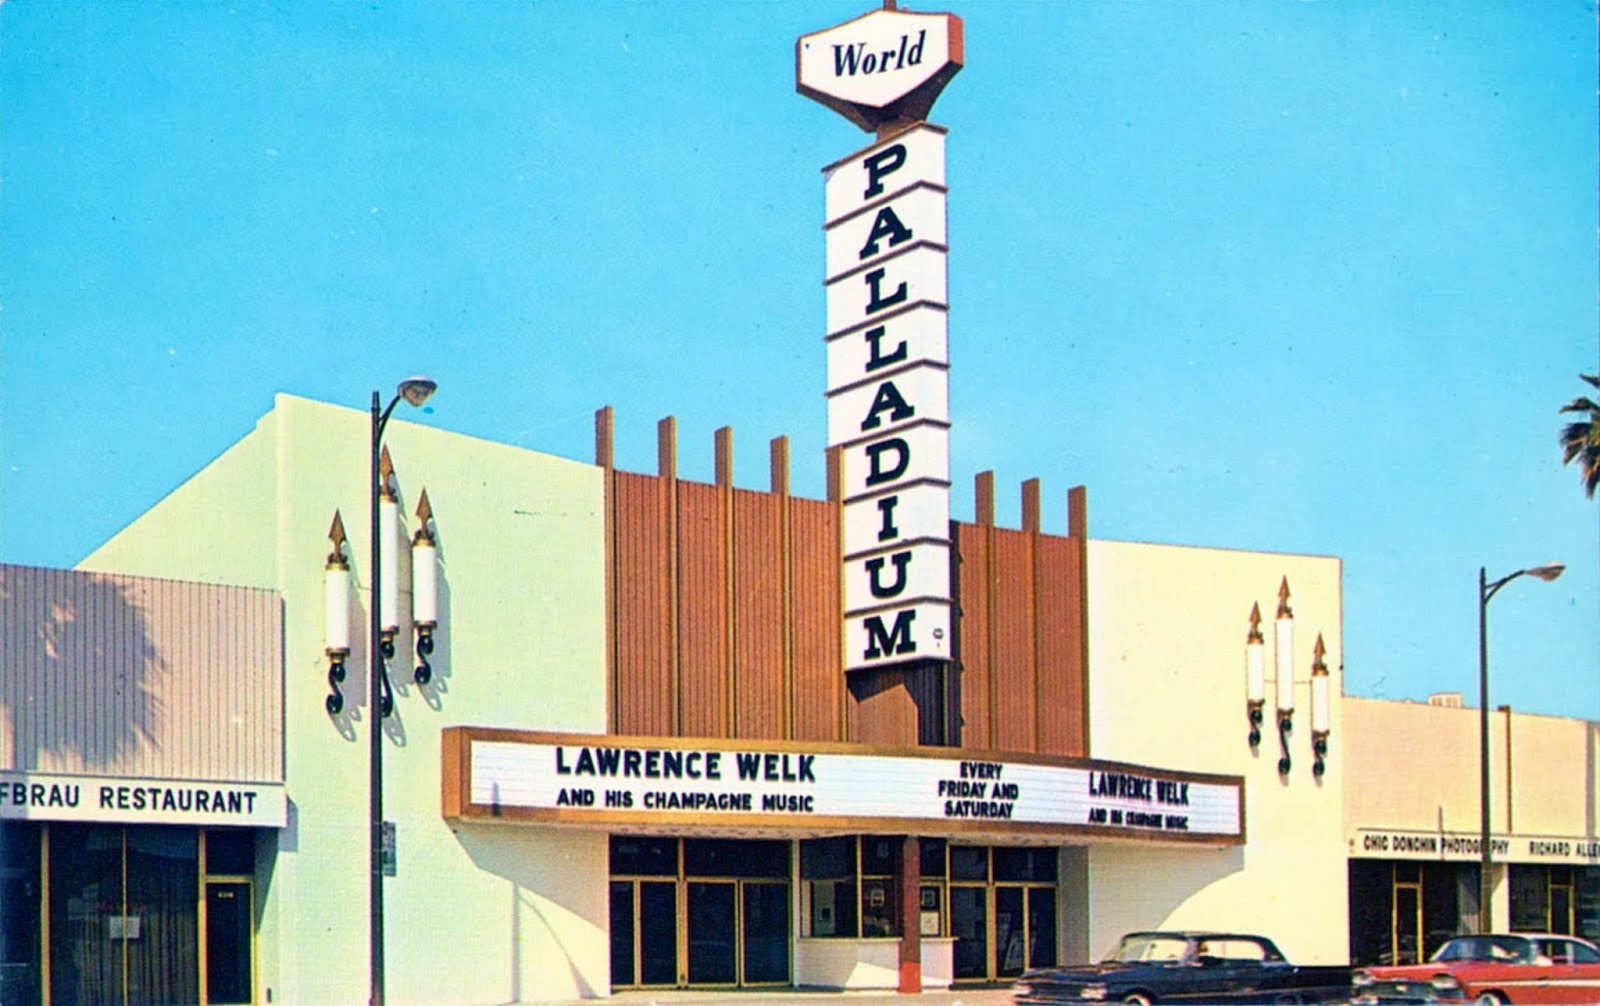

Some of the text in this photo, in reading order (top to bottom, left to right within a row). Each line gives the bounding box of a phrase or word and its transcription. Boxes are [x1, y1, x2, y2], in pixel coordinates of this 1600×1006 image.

[831, 29, 927, 77] World
[859, 143, 917, 661] PALLADIUM
[556, 747, 815, 782] LAWRENCE WELK
[960, 762, 1003, 780] EVERY
[938, 780, 1019, 800] FRIDAY AND
[1089, 770, 1189, 806] LAWRENCE WELK
[99, 786, 258, 814] RESTAURANT
[556, 788, 814, 812] AND HIS CHAMPAGNE MUSIC
[944, 800, 1014, 819] SATURDAY
[1088, 806, 1108, 823] AND
[1364, 835, 1509, 856] CHIC DONCHIN PHOTOGPHY
[1529, 841, 1600, 857] RICHARD ALLE
